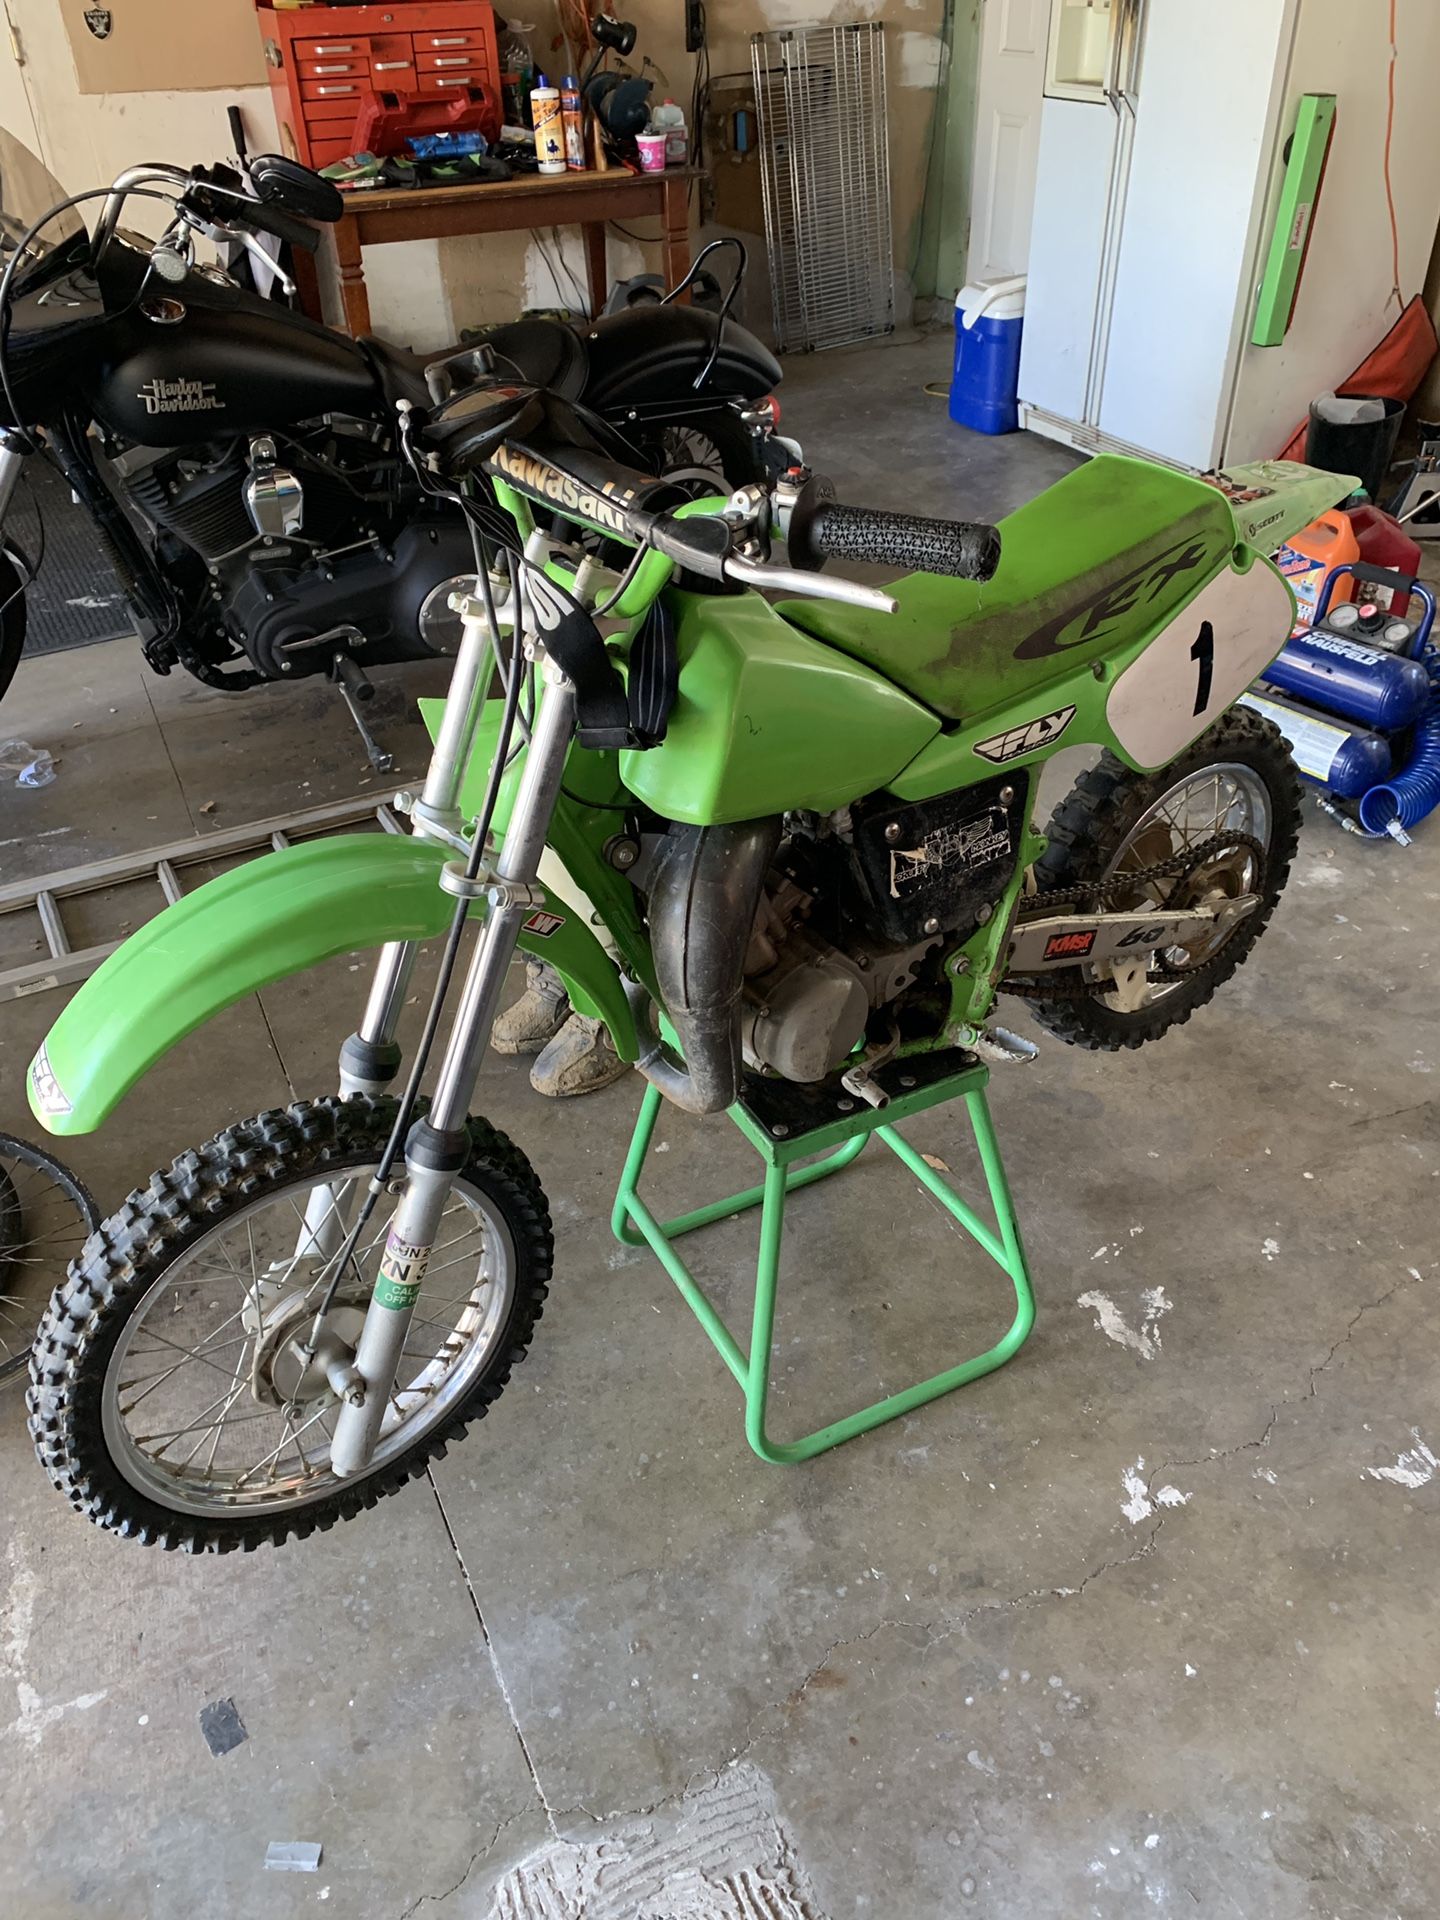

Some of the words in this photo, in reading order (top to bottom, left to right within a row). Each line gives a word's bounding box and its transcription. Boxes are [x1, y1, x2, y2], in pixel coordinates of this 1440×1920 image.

[137, 394, 226, 414] Davidson
[1301, 634, 1379, 666] HAUSFELD
[1312, 631, 1389, 661] CAMPBELL
[1190, 620, 1214, 718] 1
[999, 706, 1076, 757] FLY
[384, 1292, 407, 1304] OFF
